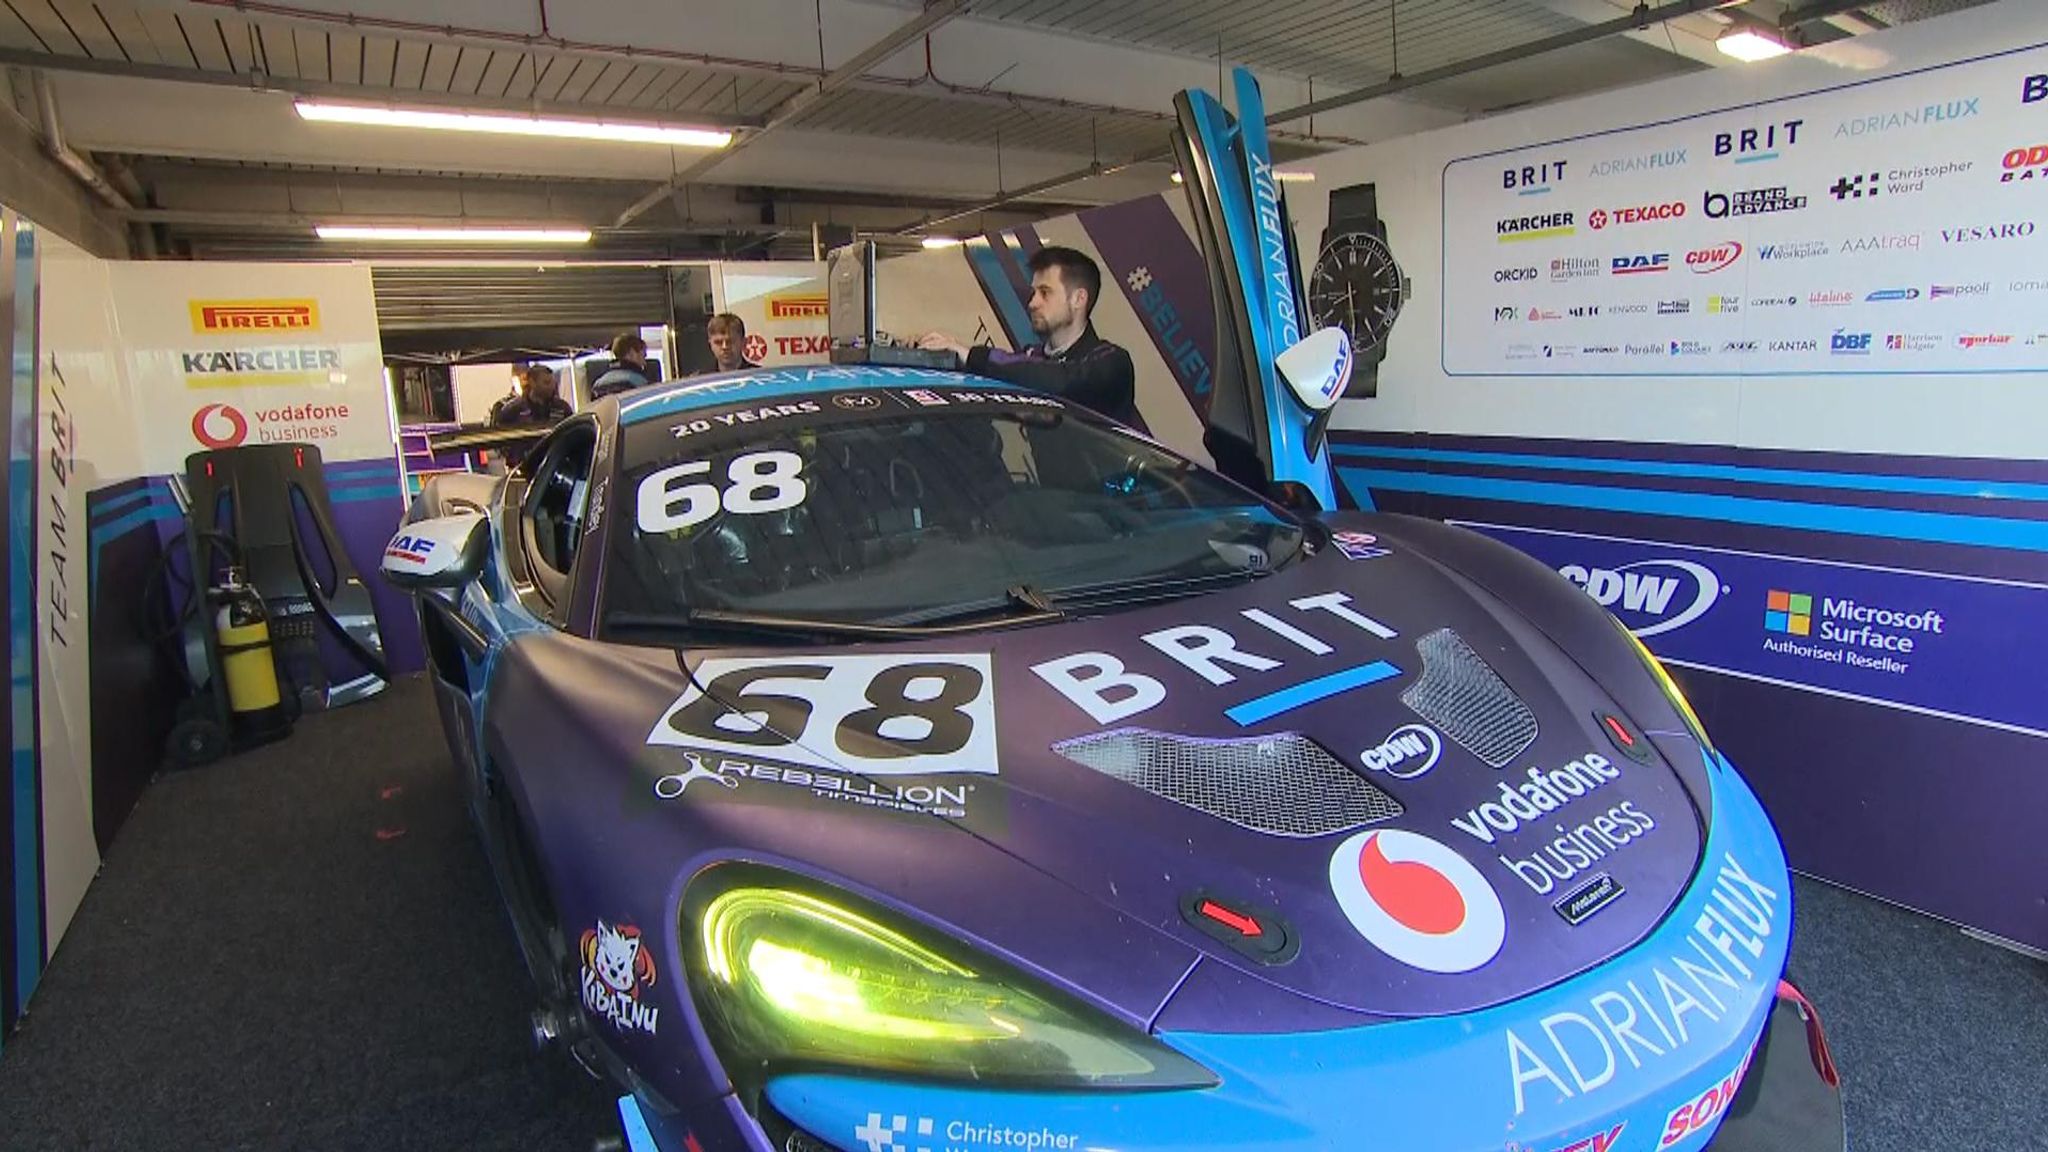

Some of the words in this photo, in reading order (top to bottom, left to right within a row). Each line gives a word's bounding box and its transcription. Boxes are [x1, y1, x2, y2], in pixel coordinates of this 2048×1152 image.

[1835, 98, 1980, 138] ADRIANFLUX
[1715, 120, 1803, 156] BRIT
[1503, 161, 1568, 189] BRIT
[1589, 150, 1687, 177] ADRIANFLUX
[1888, 162, 1973, 180] Christopher
[1733, 188, 1786, 203] BRAND
[1888, 181, 1924, 194] Ward
[1613, 202, 1686, 224] TEXACO
[1732, 196, 1807, 216] ADVANCE
[1497, 212, 1574, 233] KÄRCHER
[1940, 221, 2035, 243] VESARO
[1252, 152, 1300, 347] DRIANFLUX
[1561, 257, 1600, 270] Hilton
[1612, 254, 1669, 268] DAF
[1685, 249, 1730, 264] CDW
[202, 307, 310, 328] PIRELLI
[1624, 343, 1665, 355] Parallel
[1769, 341, 1817, 351] KANTAR
[1831, 333, 1872, 349] DBF
[182, 350, 341, 372] KÄRCHER
[1321, 339, 1347, 395] DAF
[50, 350, 66, 488] BRIT
[255, 404, 349, 422] vodafone
[670, 420, 711, 439] 20
[714, 401, 821, 427] YEARS
[258, 424, 338, 443] business
[637, 450, 806, 533] 68
[50, 495, 67, 647] TEAM
[1556, 566, 1679, 615] CDW
[1822, 597, 1944, 633] Microsoft
[1820, 621, 1914, 653] Surface
[1028, 592, 1399, 725] BRIT
[1763, 638, 1842, 663] Authorised
[1846, 651, 1908, 674] Reseller
[668, 664, 984, 760] 68
[1360, 732, 1428, 770] CDW
[717, 760, 966, 804] REBELLION
[1450, 752, 1621, 844] vodafone
[1499, 800, 1656, 895] business
[1506, 851, 1777, 1115] ADRIANFLUX
[946, 1120, 1079, 1150] Christopher
